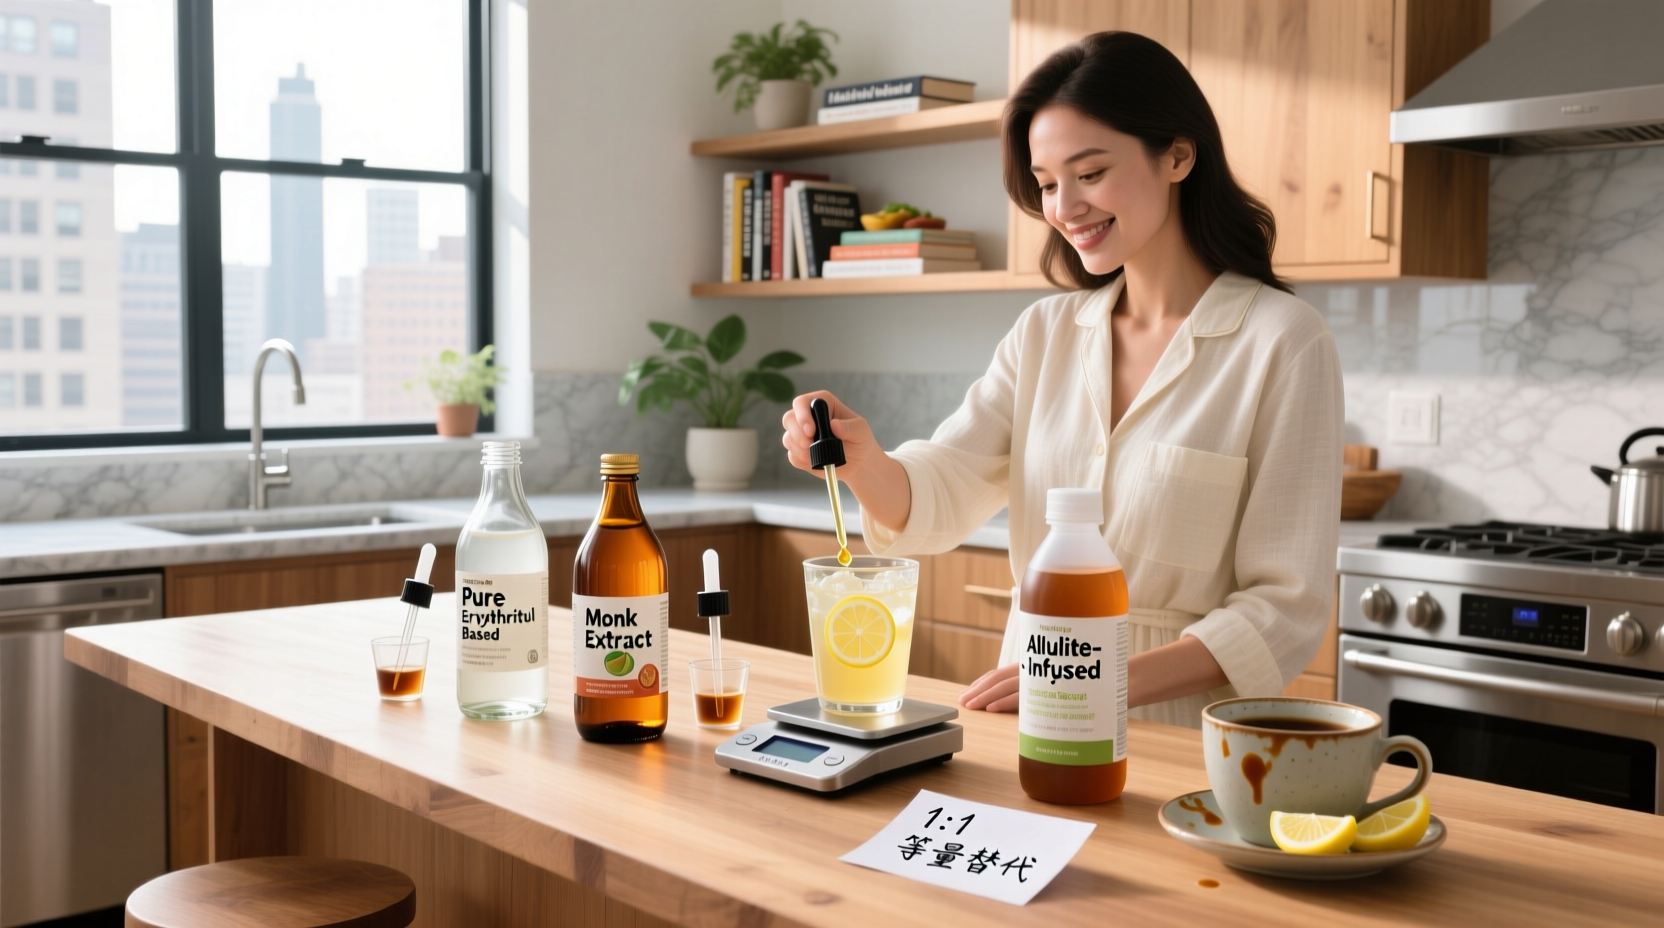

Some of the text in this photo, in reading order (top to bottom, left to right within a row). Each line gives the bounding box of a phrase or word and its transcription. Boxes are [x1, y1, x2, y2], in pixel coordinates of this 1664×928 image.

[462, 587, 506, 607] Pure
[585, 607, 638, 627] Monk
[462, 626, 500, 641] Based
[585, 630, 652, 649] Extract
[1026, 634, 1102, 657] Allulite-
[924, 807, 975, 835] 1:1
[897, 834, 1037, 883] 等量替代
